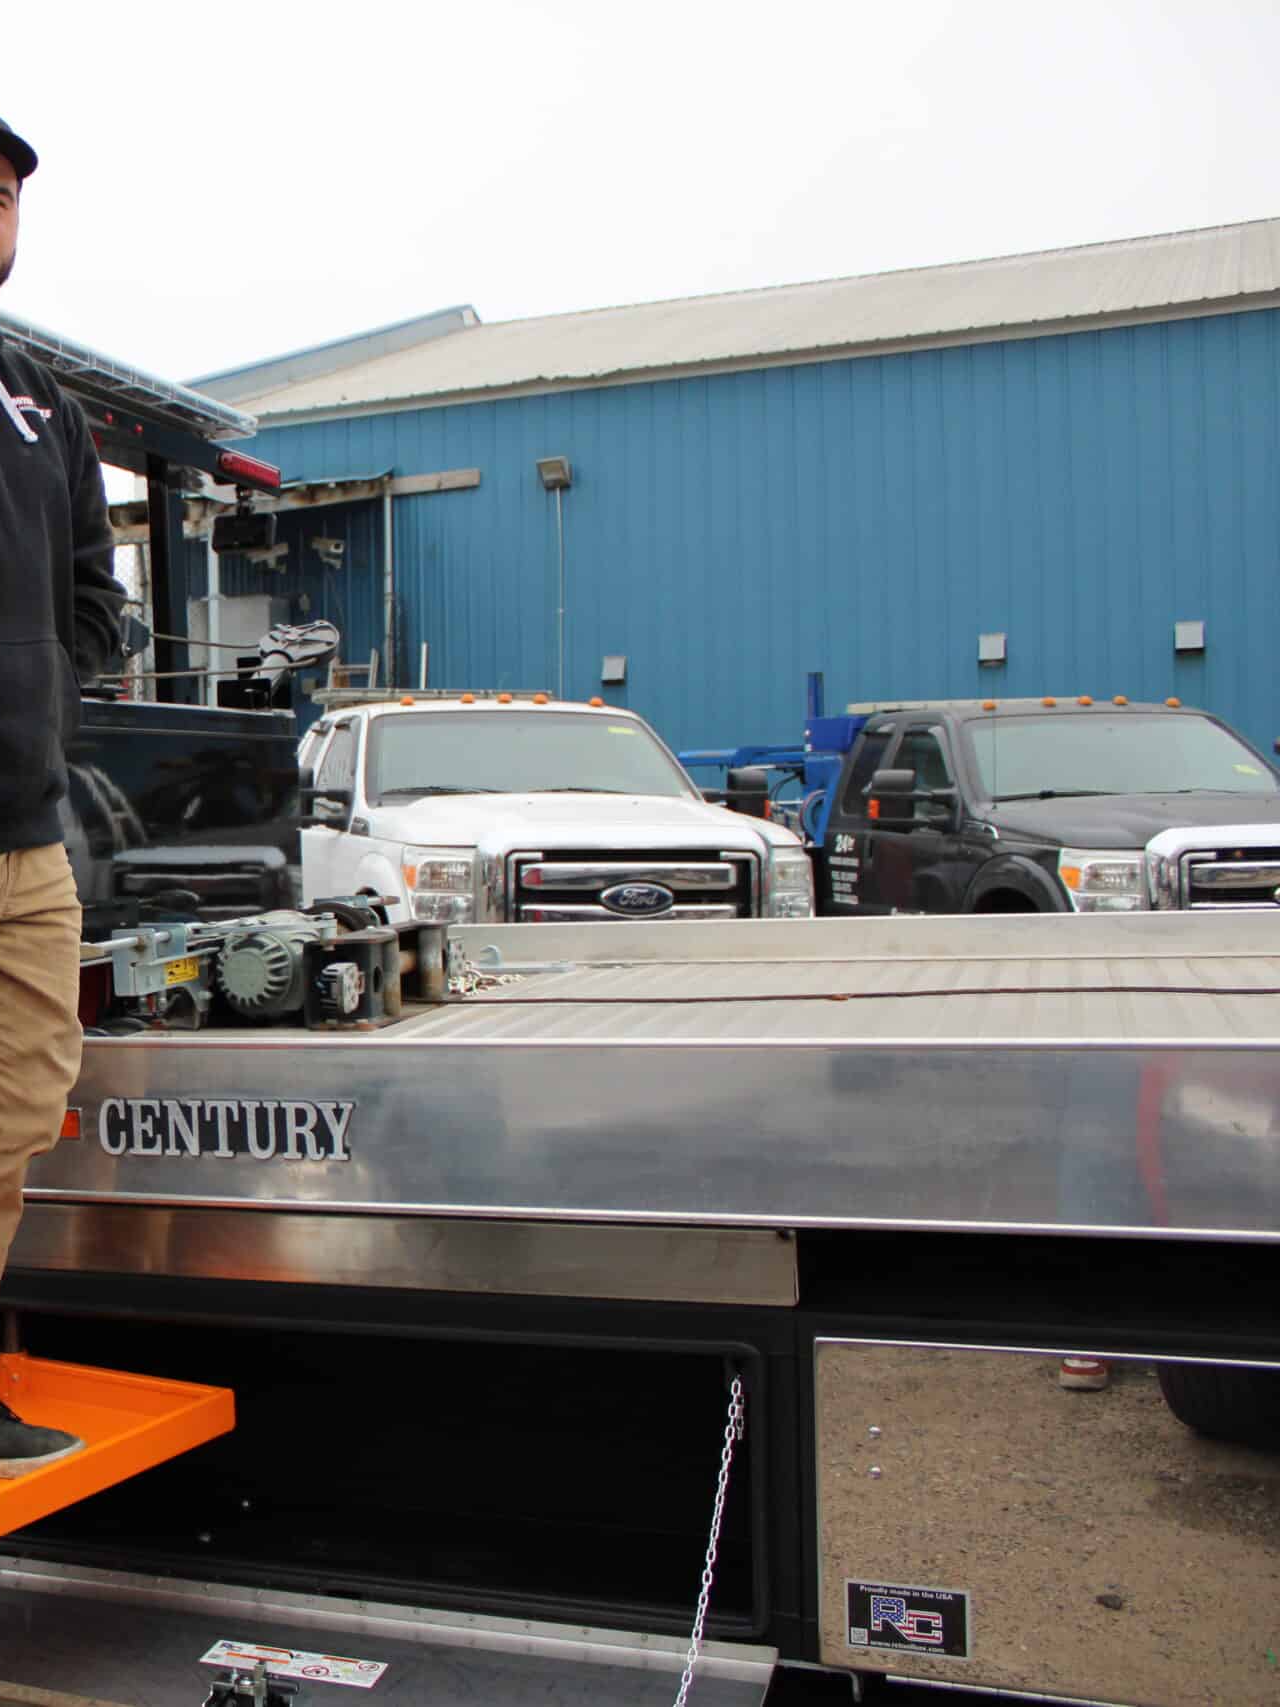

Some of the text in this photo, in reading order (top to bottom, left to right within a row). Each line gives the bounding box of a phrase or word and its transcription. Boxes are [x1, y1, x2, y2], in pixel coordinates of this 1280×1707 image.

[619, 888, 659, 905] Ford
[98, 1096, 355, 1162] CENTURY
[859, 1585, 888, 1595] Proudly
[889, 1589, 911, 1597] made
[935, 1593, 953, 1601] USA
[871, 1595, 943, 1644] RC
